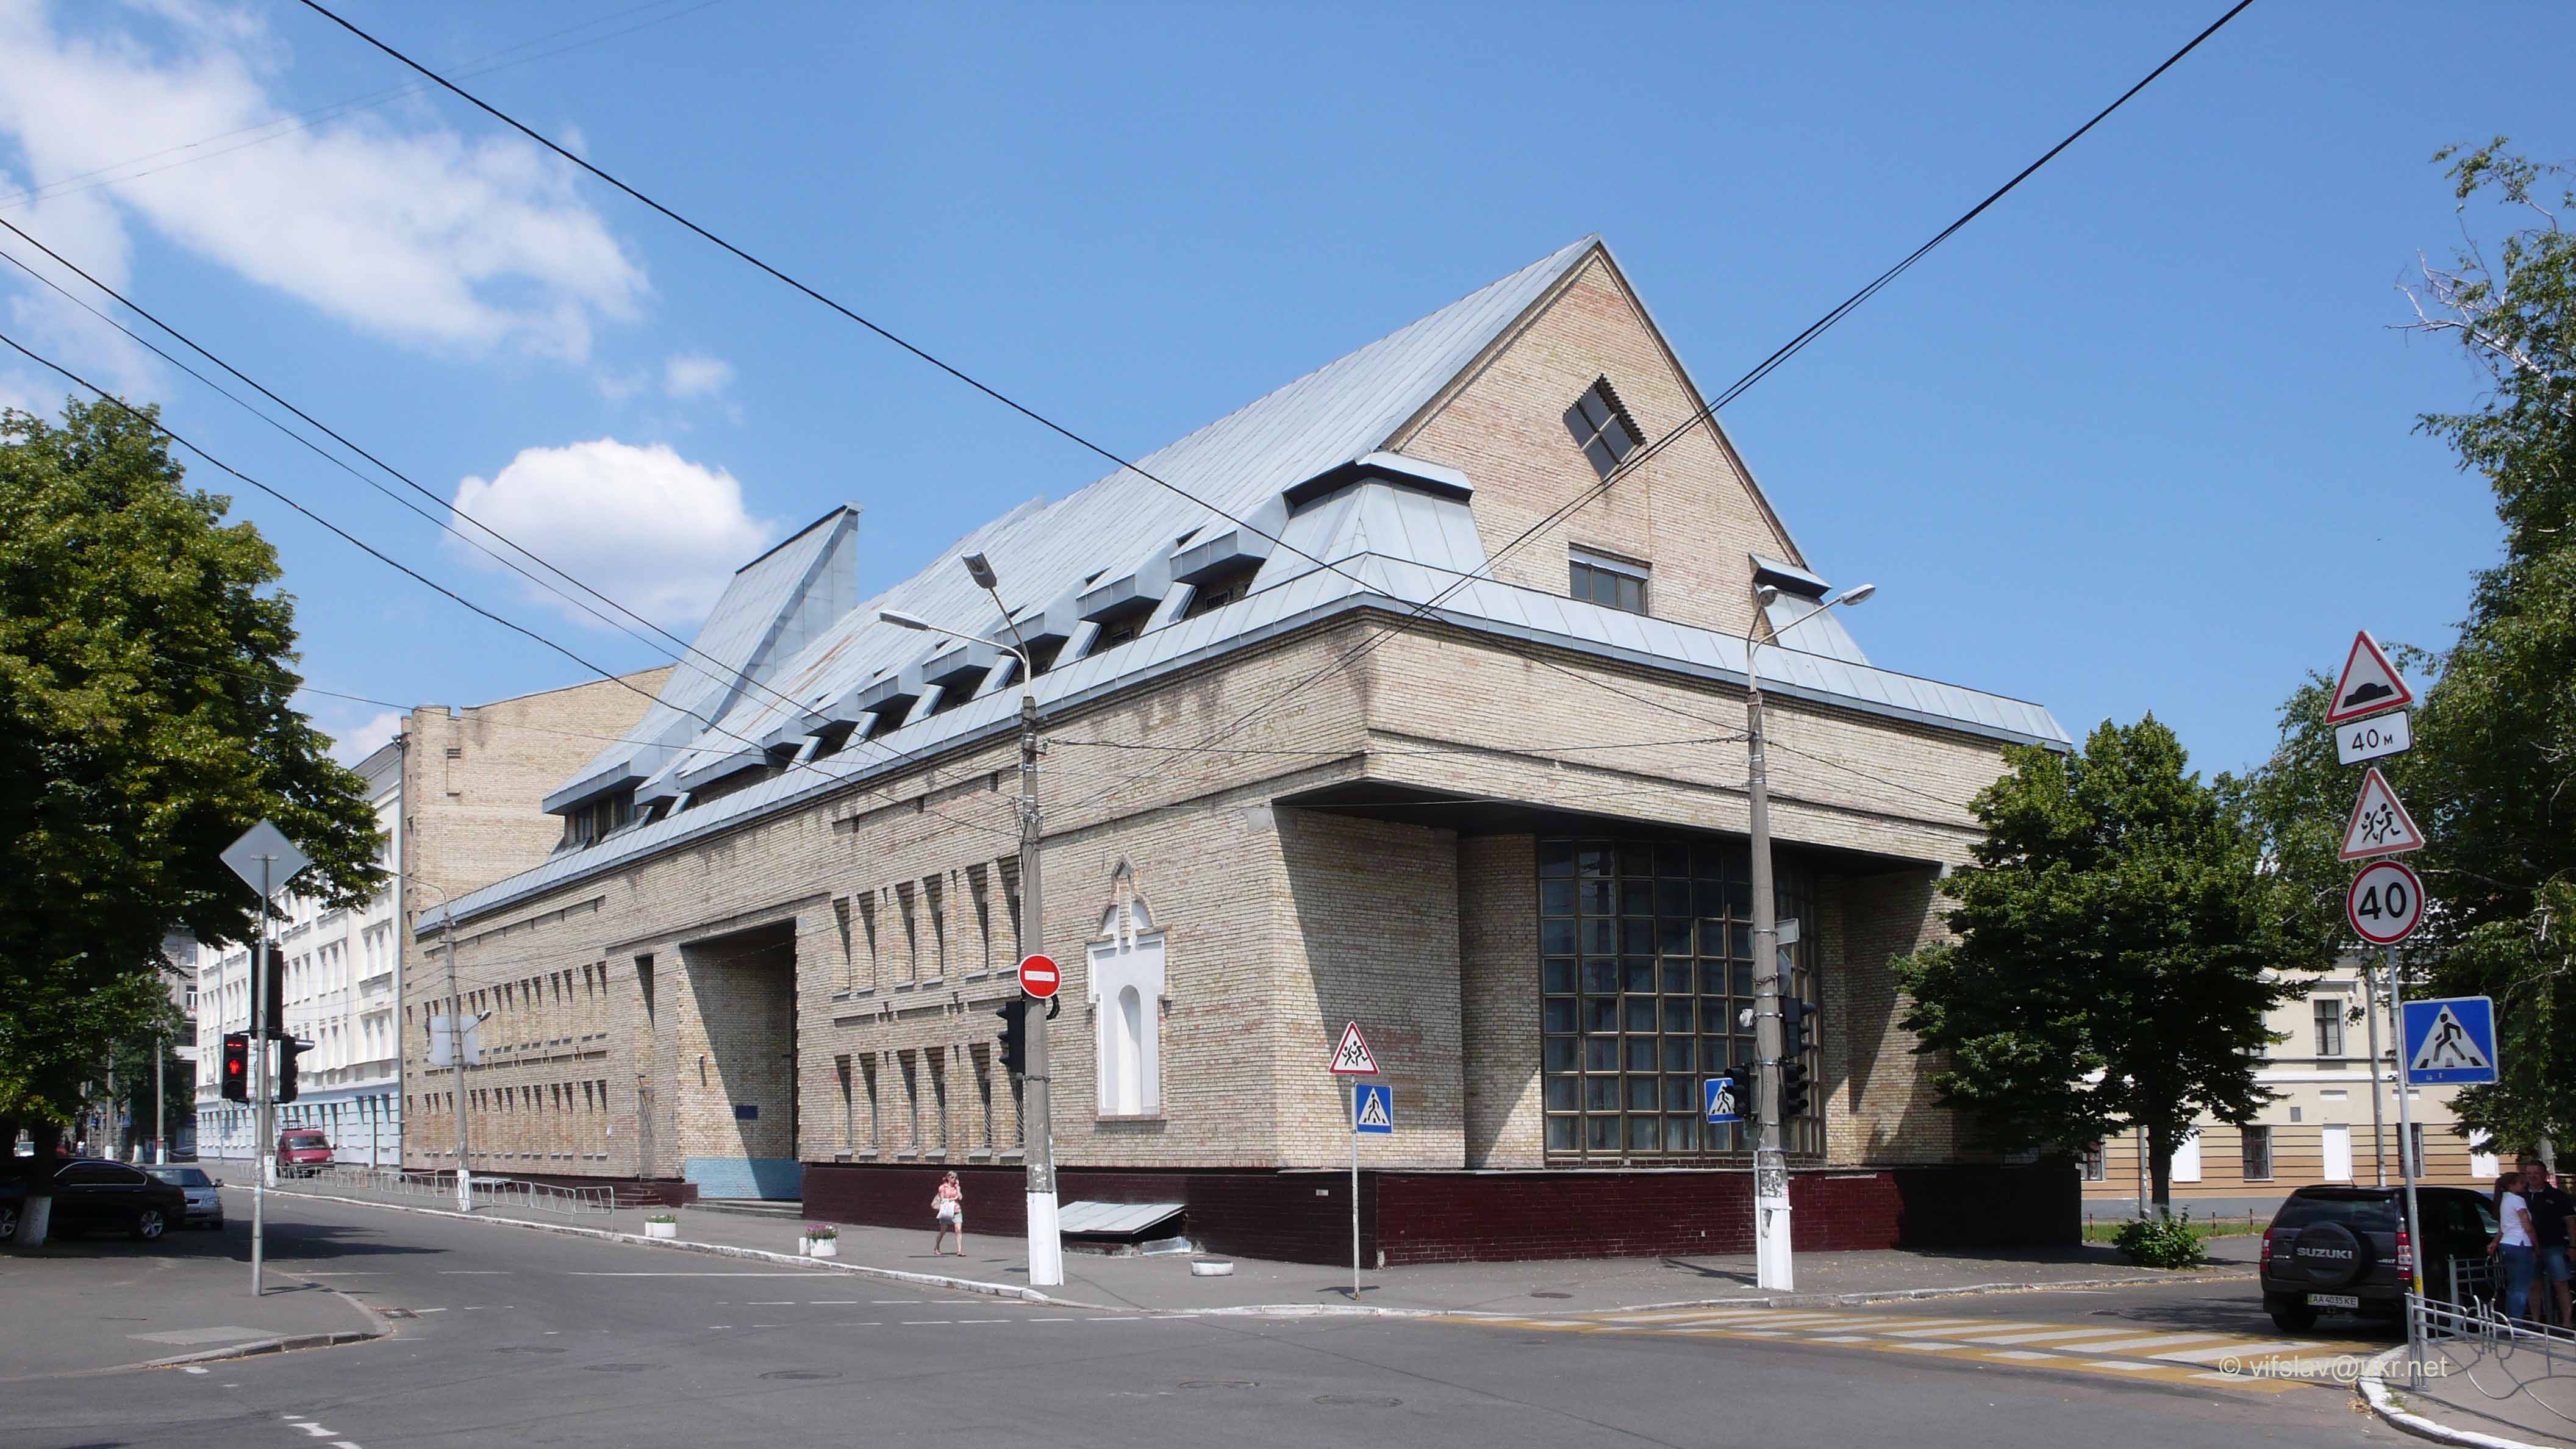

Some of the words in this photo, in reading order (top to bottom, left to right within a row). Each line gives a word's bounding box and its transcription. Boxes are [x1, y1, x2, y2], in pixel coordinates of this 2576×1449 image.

[2352, 729, 2378, 751] 40
[2358, 882, 2406, 920] 40
[2297, 1247, 2352, 1259] SUZUKI
